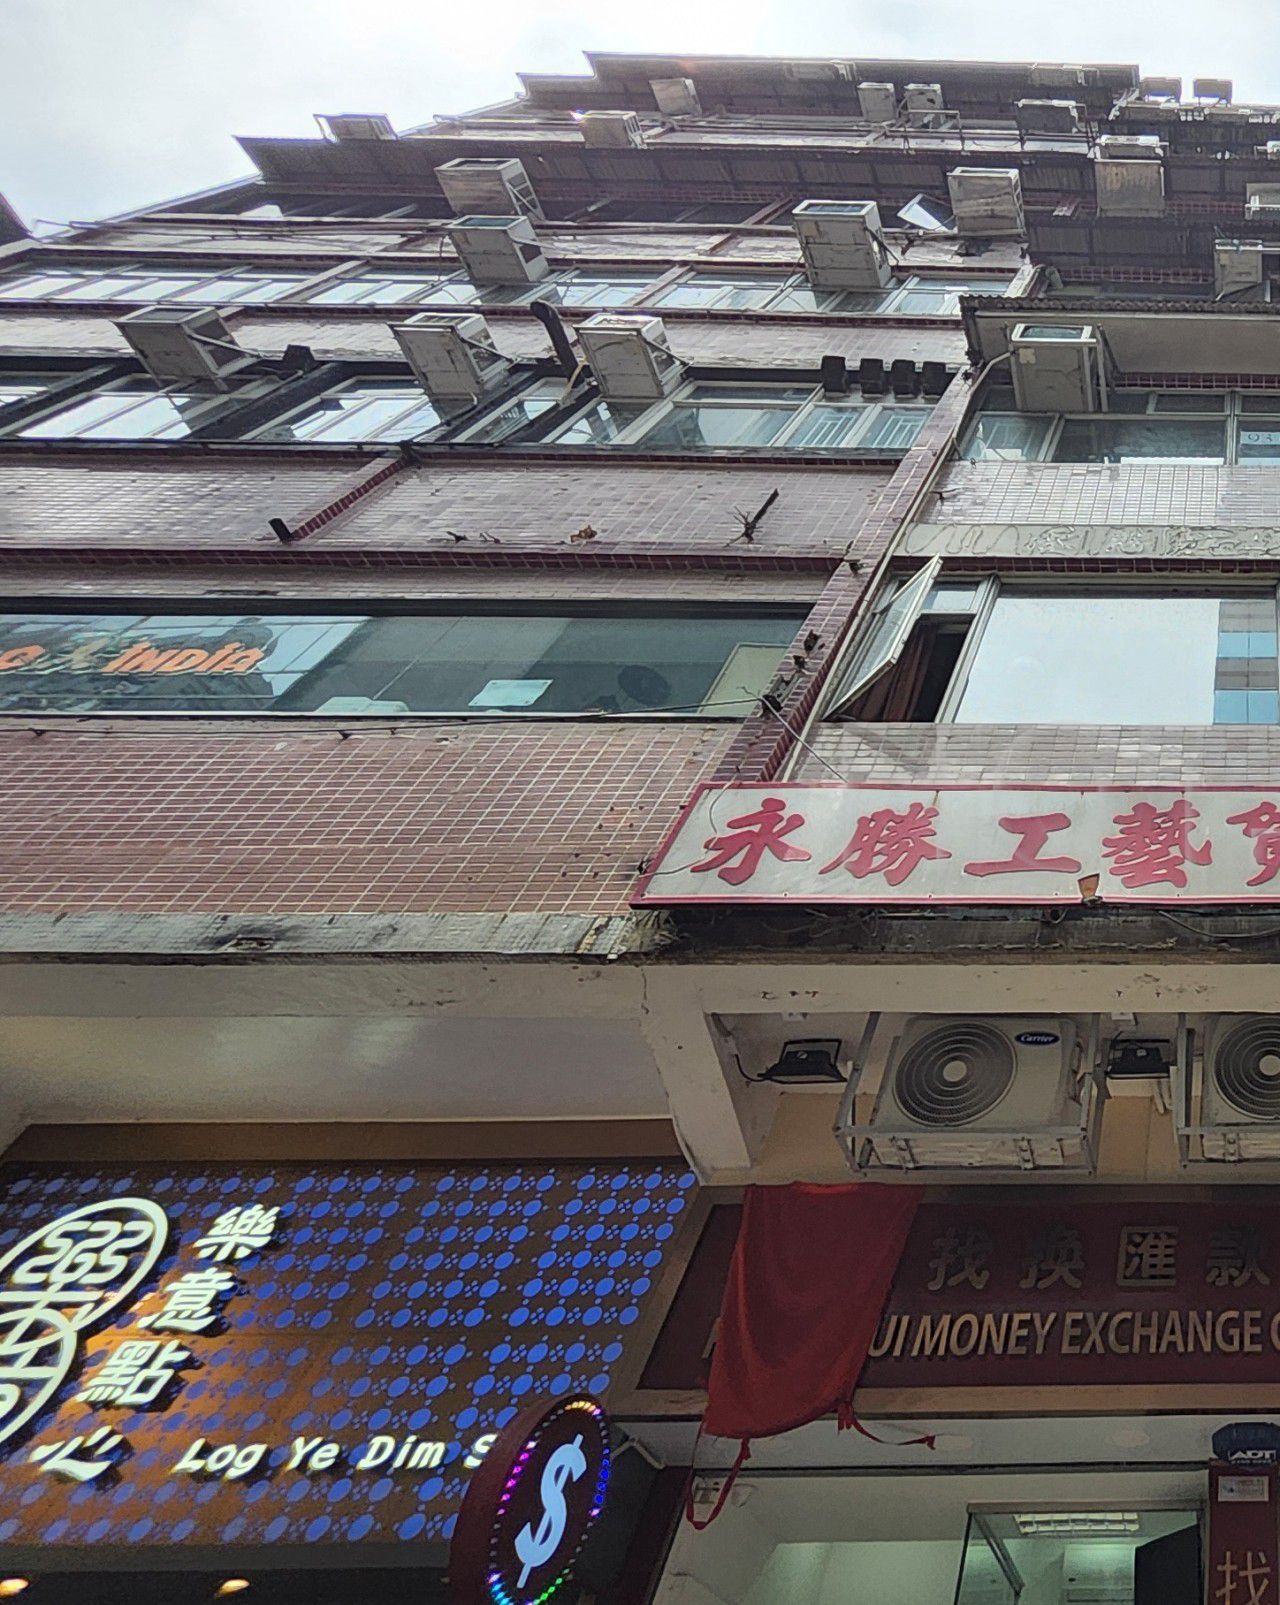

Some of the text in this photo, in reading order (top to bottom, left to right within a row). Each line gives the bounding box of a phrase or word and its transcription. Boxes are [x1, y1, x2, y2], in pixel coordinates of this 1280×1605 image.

[29, 1203, 281, 1482] 樂意點心
[911, 1312, 1056, 1357] MONEY
[1061, 1310, 1263, 1354] EXCHANGE
[172, 1438, 268, 1480] Log
[285, 1436, 341, 1470] Ye
[357, 1435, 446, 1470] Dim
[1230, 1450, 1276, 1459] ADT
